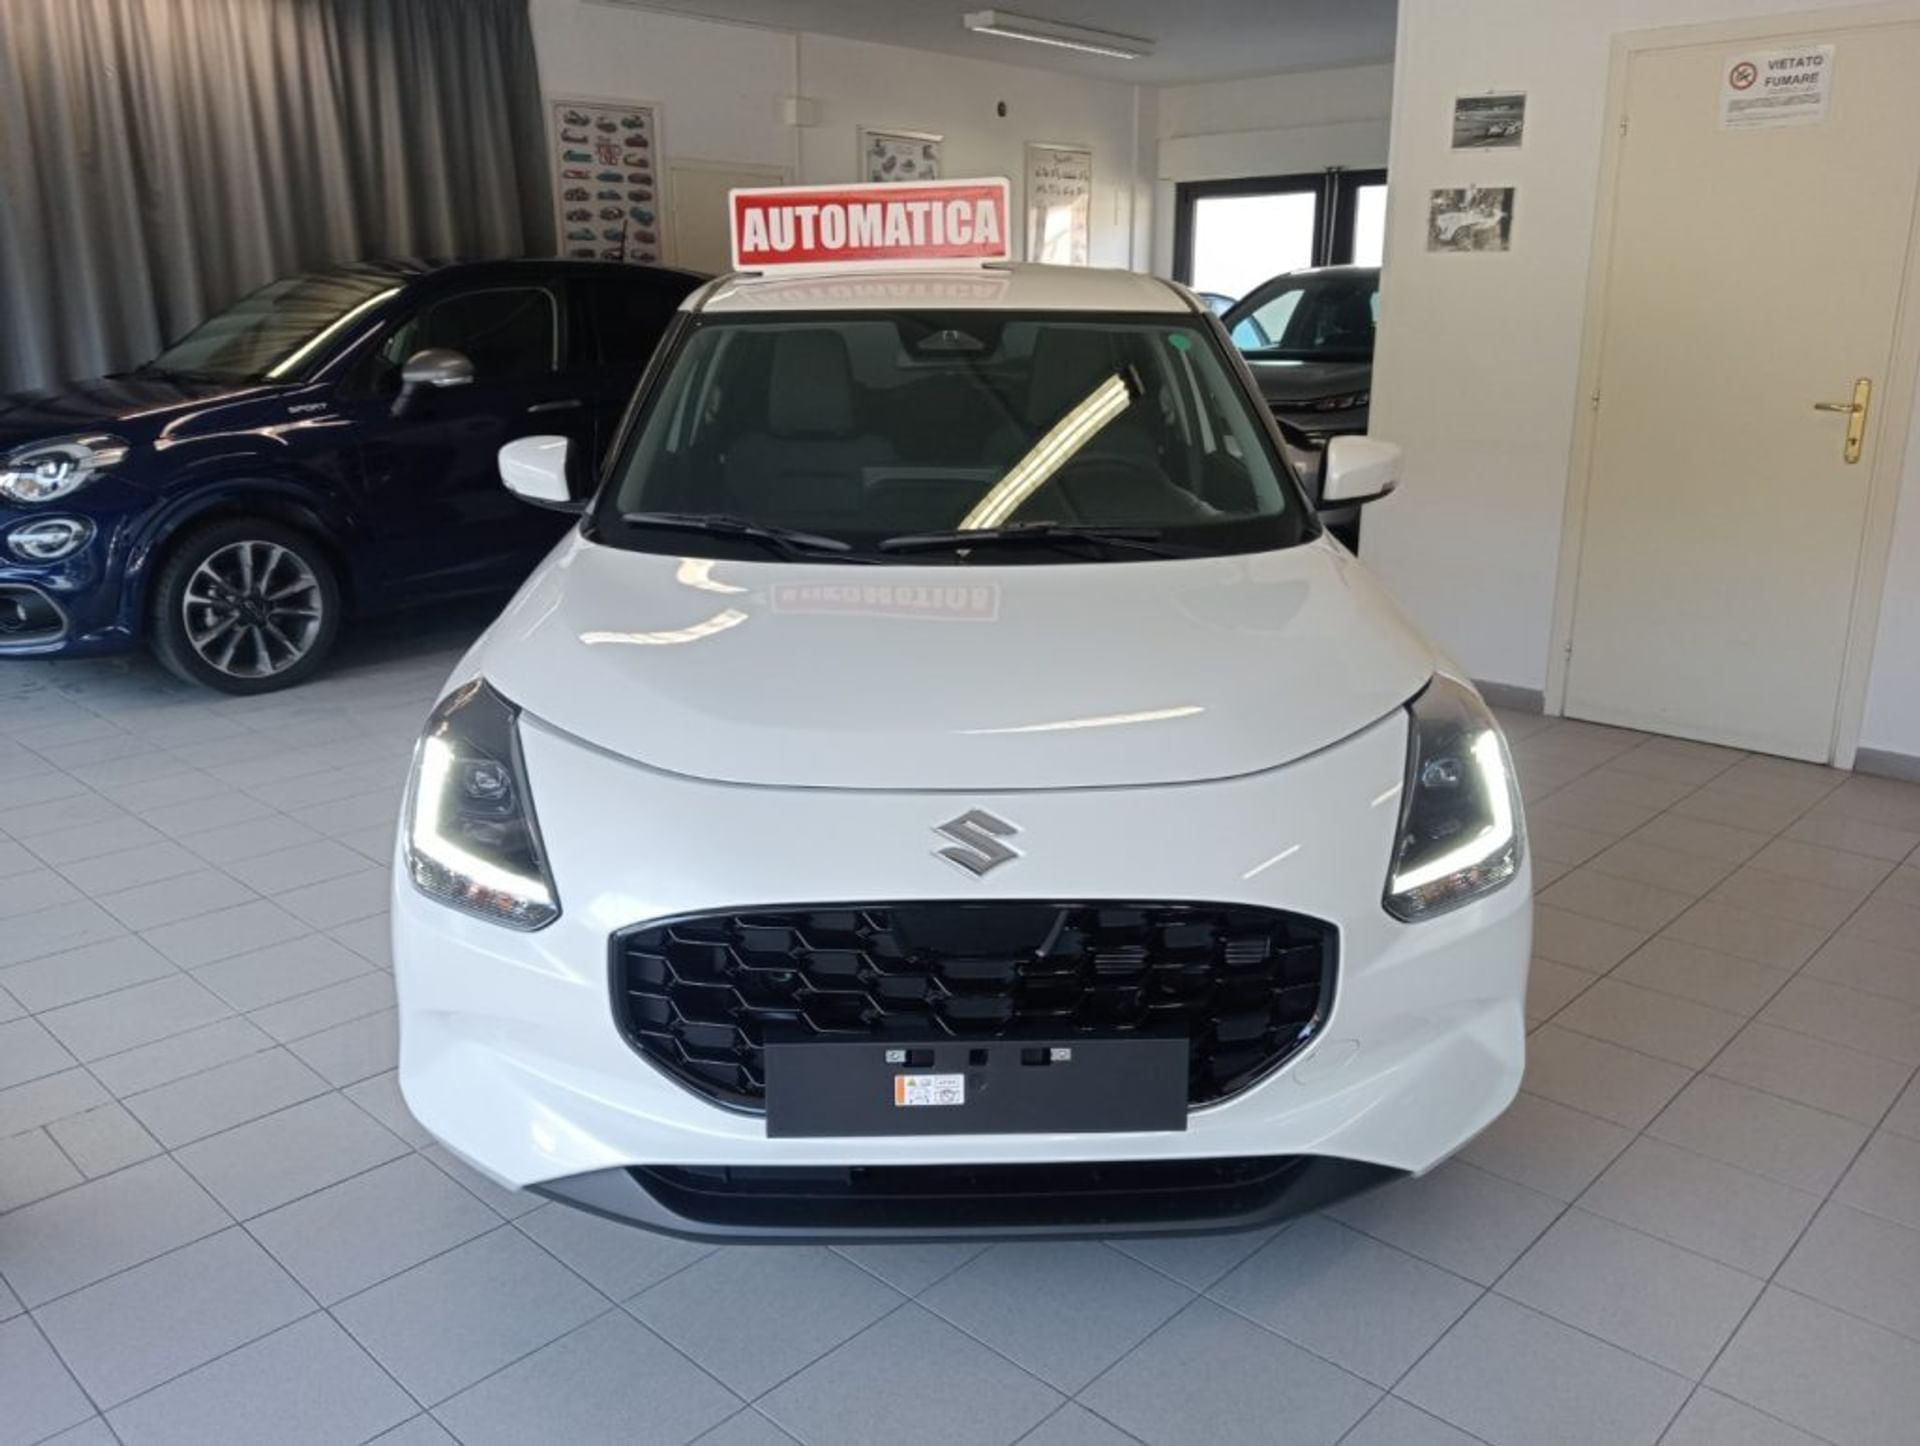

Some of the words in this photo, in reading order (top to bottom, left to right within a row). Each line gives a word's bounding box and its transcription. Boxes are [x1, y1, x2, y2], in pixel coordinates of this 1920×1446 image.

[1768, 56, 1824, 70] VIETATO
[1764, 73, 1819, 87] FUMARE
[742, 199, 1000, 253] AUTOMATICA
